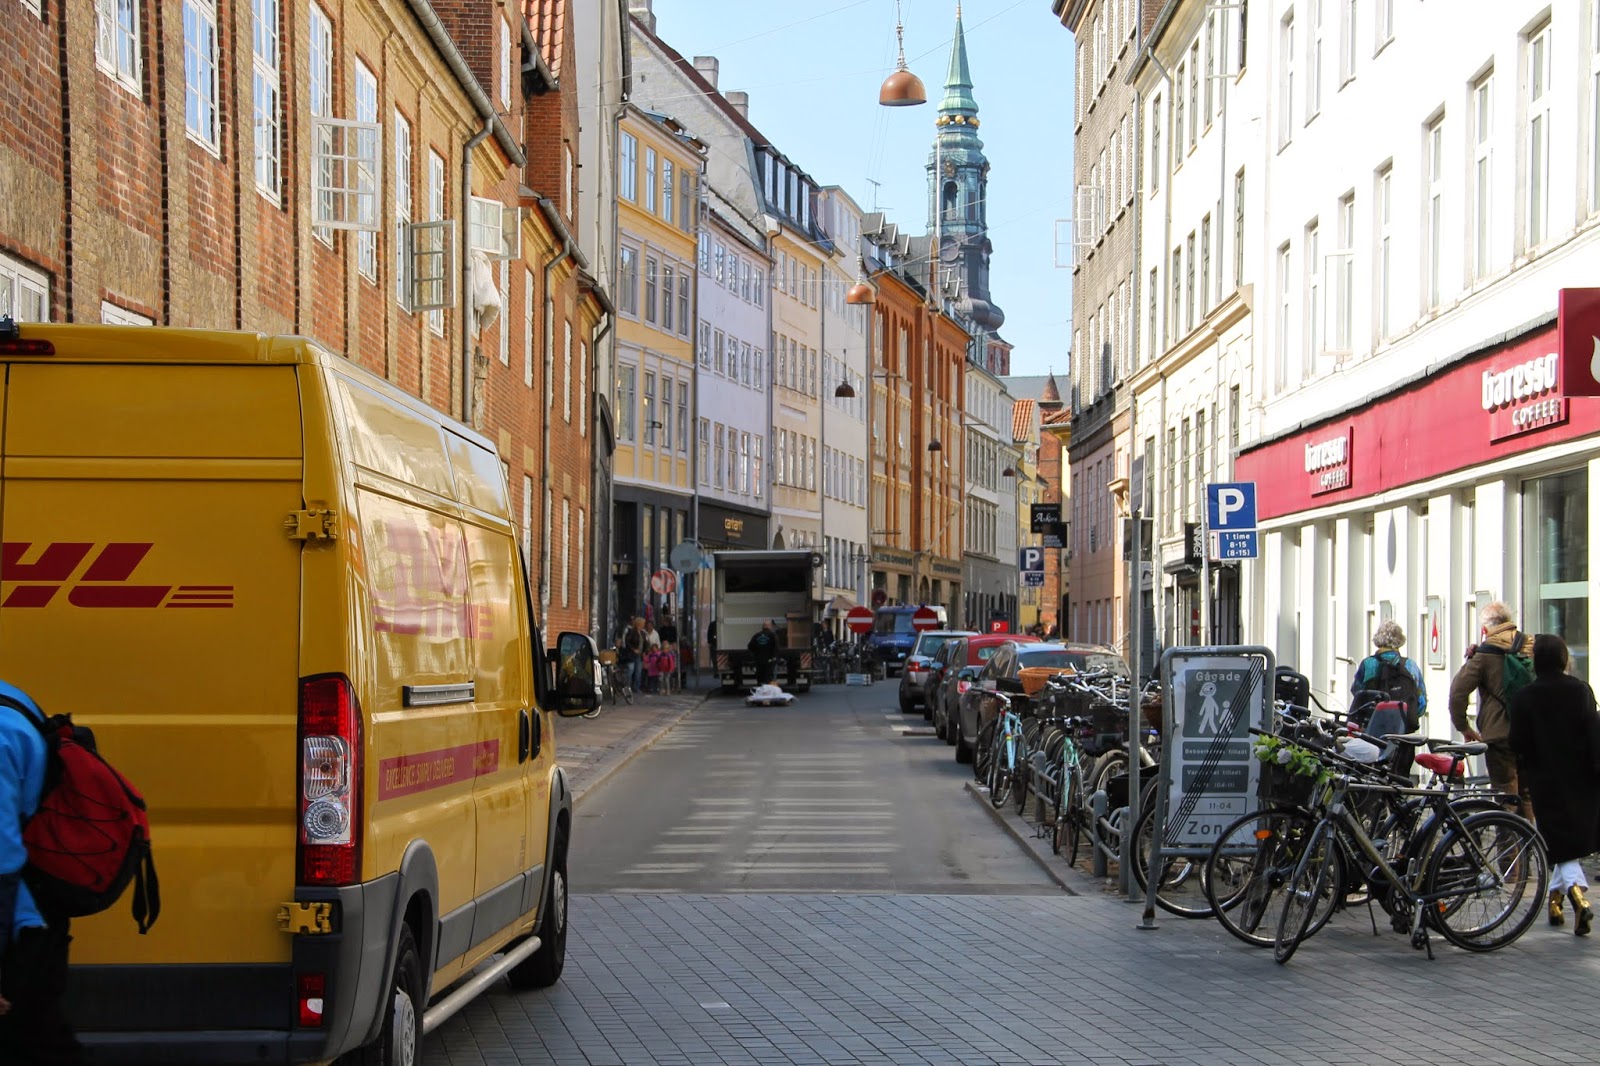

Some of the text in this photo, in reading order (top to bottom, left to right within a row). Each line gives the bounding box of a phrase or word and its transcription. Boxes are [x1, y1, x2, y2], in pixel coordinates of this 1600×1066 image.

[1482, 353, 1558, 410] baresso
[1512, 398, 1558, 426] COFFEE
[1218, 488, 1245, 525] P
[1025, 549, 1040, 569] P
[993, 622, 1001, 632] P
[1195, 671, 1241, 683] Gågade
[1187, 821, 1231, 835] Zon
